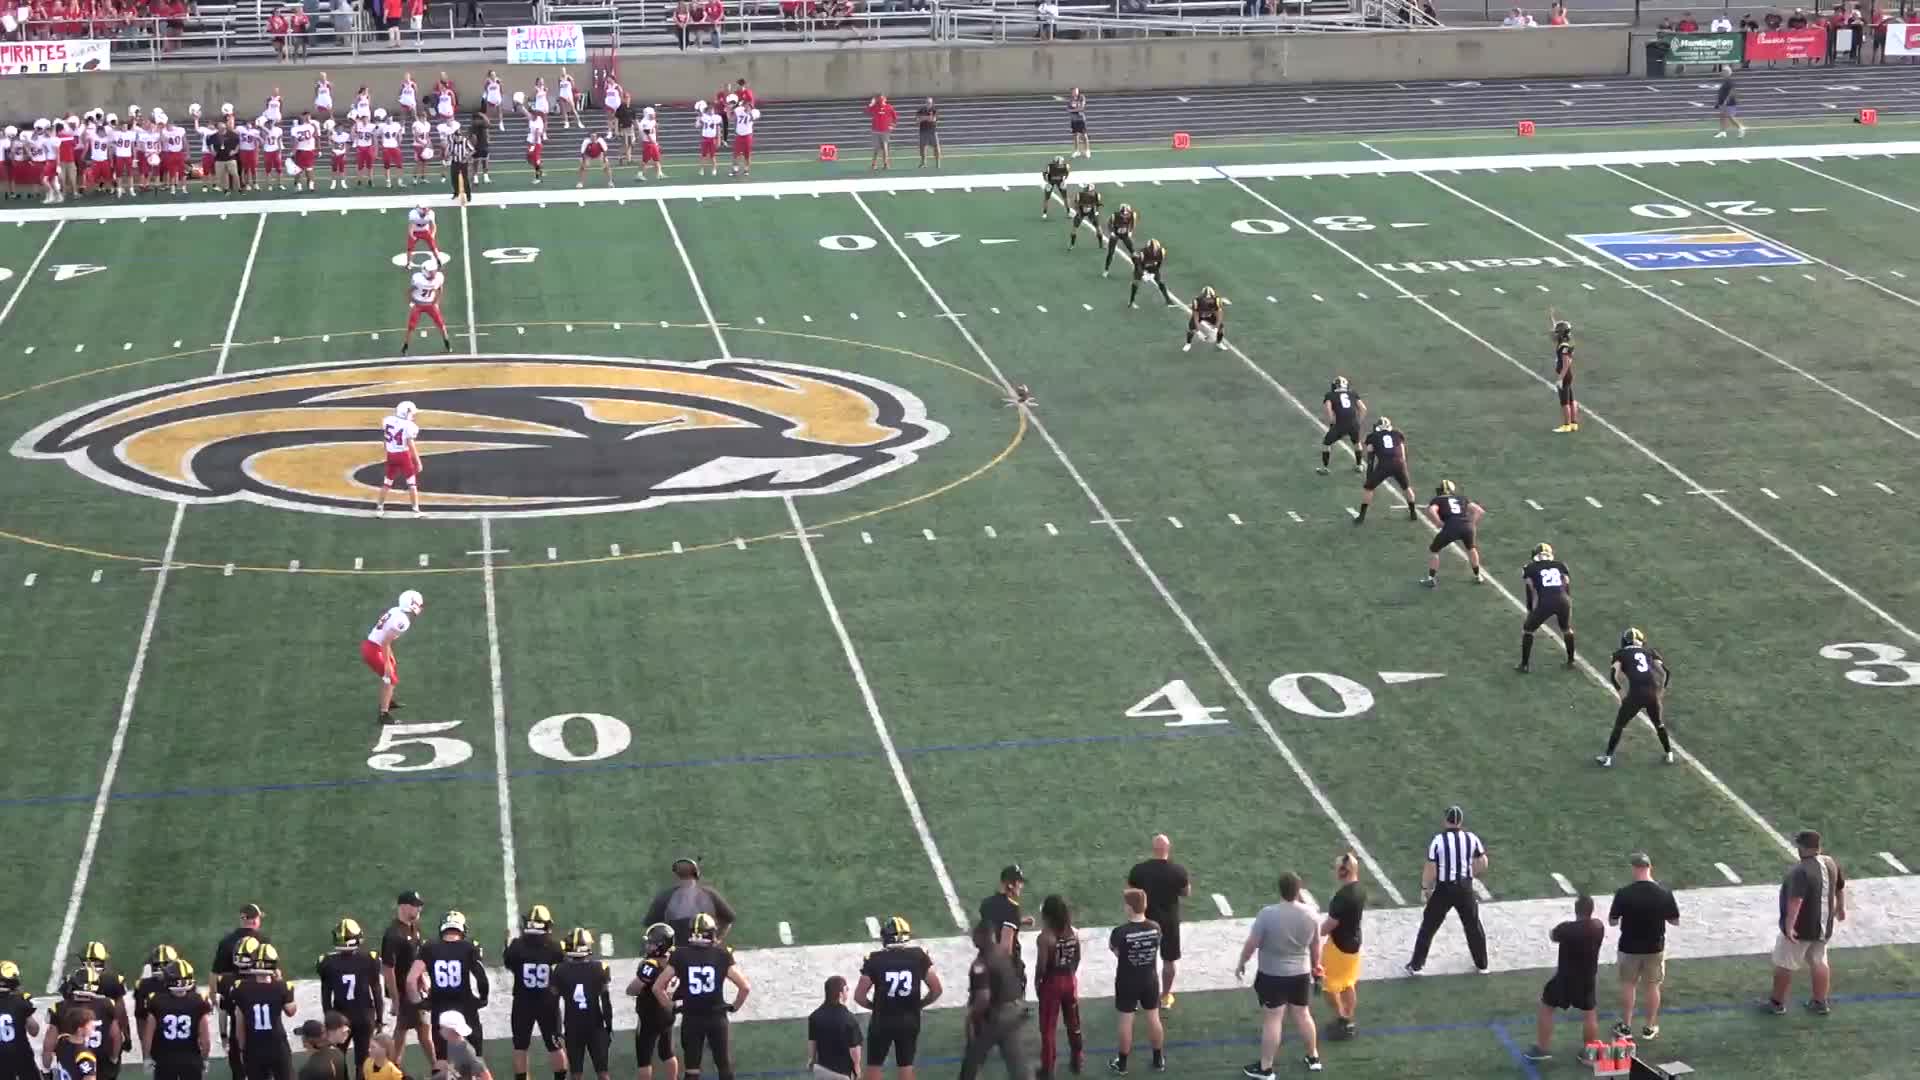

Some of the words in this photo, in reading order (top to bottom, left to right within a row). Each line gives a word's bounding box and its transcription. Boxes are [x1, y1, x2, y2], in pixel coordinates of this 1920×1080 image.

[0, 44, 67, 63] PIRATES
[515, 36, 578, 50] BIRTHDAY
[1623, 246, 1787, 262] Lake
[385, 423, 405, 446] 54
[1448, 497, 1461, 514] 5
[1634, 652, 1649, 673] 3
[342, 973, 356, 1000] 7
[433, 959, 462, 988] 68
[523, 963, 550, 989] 59
[687, 965, 716, 995] 53
[885, 970, 913, 998] 73
[573, 983, 588, 1009] 4
[162, 1013, 192, 1040] 33
[252, 1003, 272, 1031] 11
